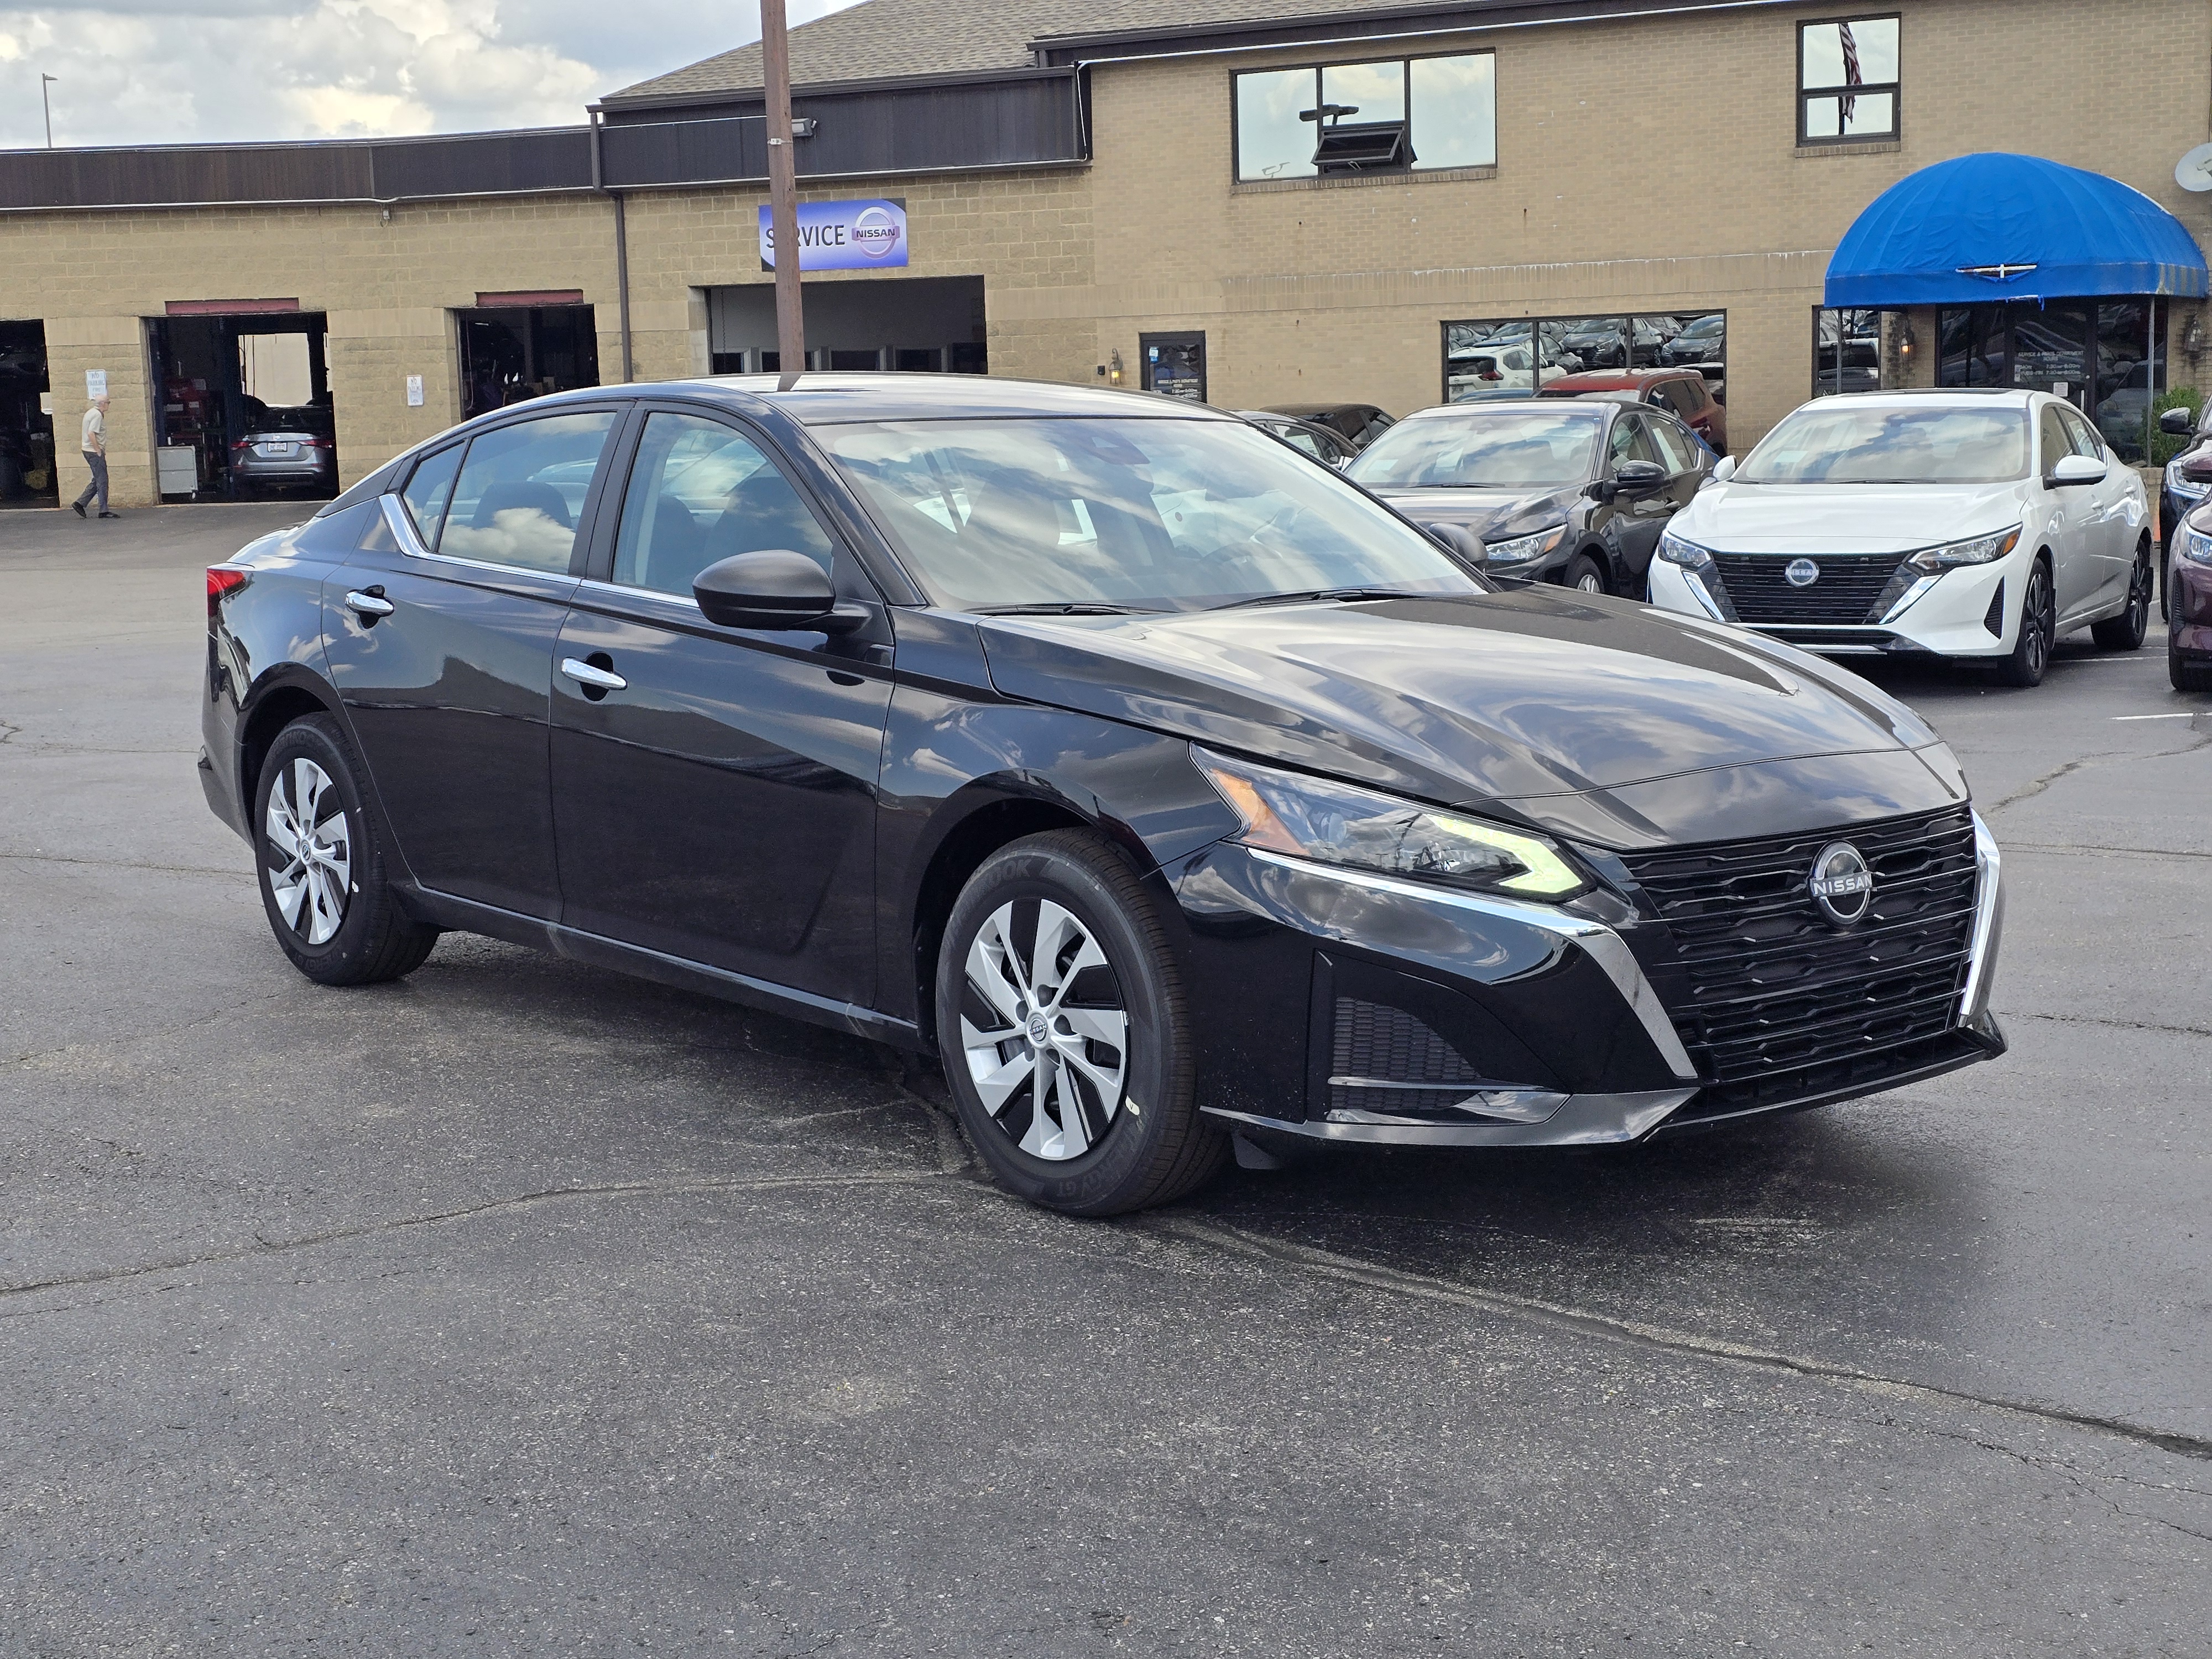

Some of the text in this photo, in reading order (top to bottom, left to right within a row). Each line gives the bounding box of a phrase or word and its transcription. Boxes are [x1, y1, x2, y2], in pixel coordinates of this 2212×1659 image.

[766, 225, 895, 248] SVICE NISSAN
[1813, 875, 1872, 895] NISSAN
